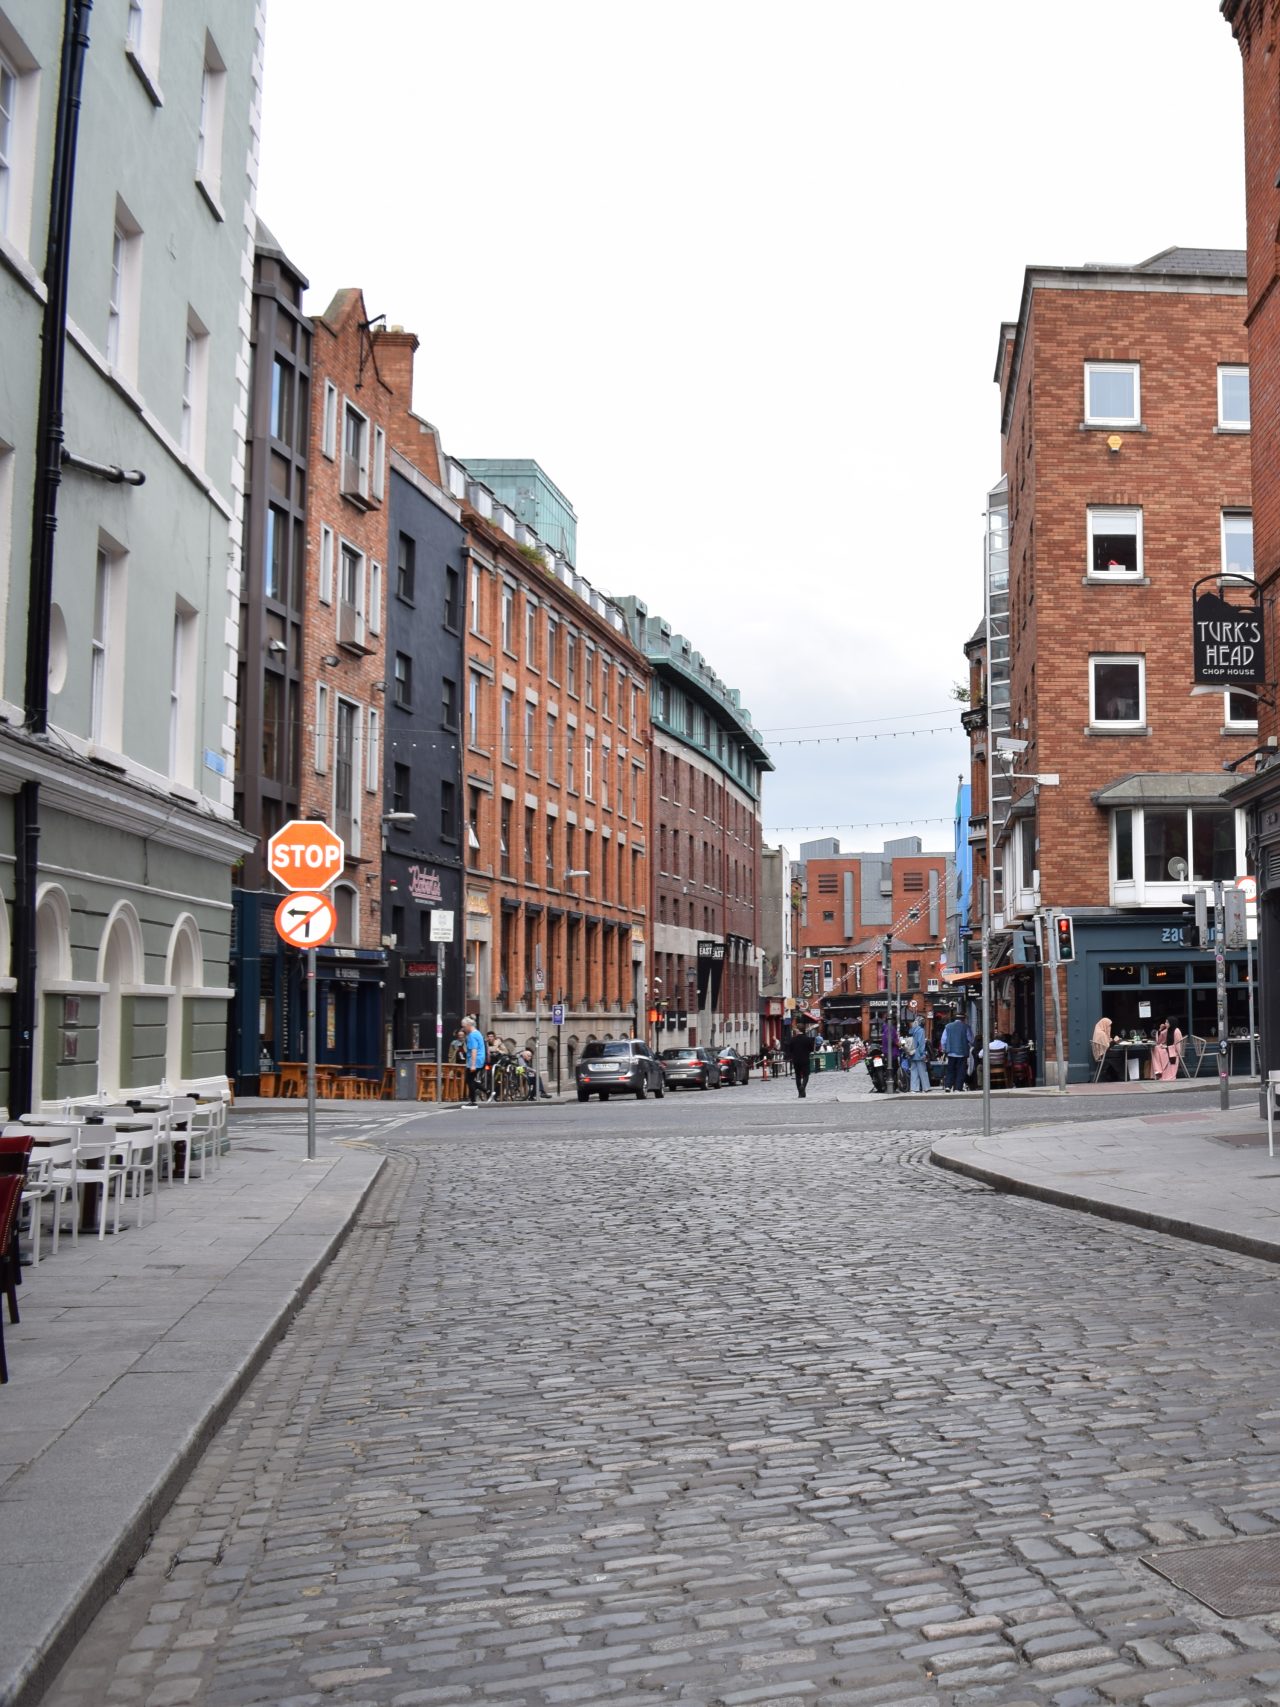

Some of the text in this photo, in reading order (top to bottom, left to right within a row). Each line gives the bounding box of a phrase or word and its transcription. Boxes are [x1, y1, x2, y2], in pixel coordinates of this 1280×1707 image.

[1196, 621, 1261, 643] TURK'S
[1206, 645, 1254, 666] HEAD
[273, 844, 340, 868] STOP
[699, 947, 712, 955] EAST
